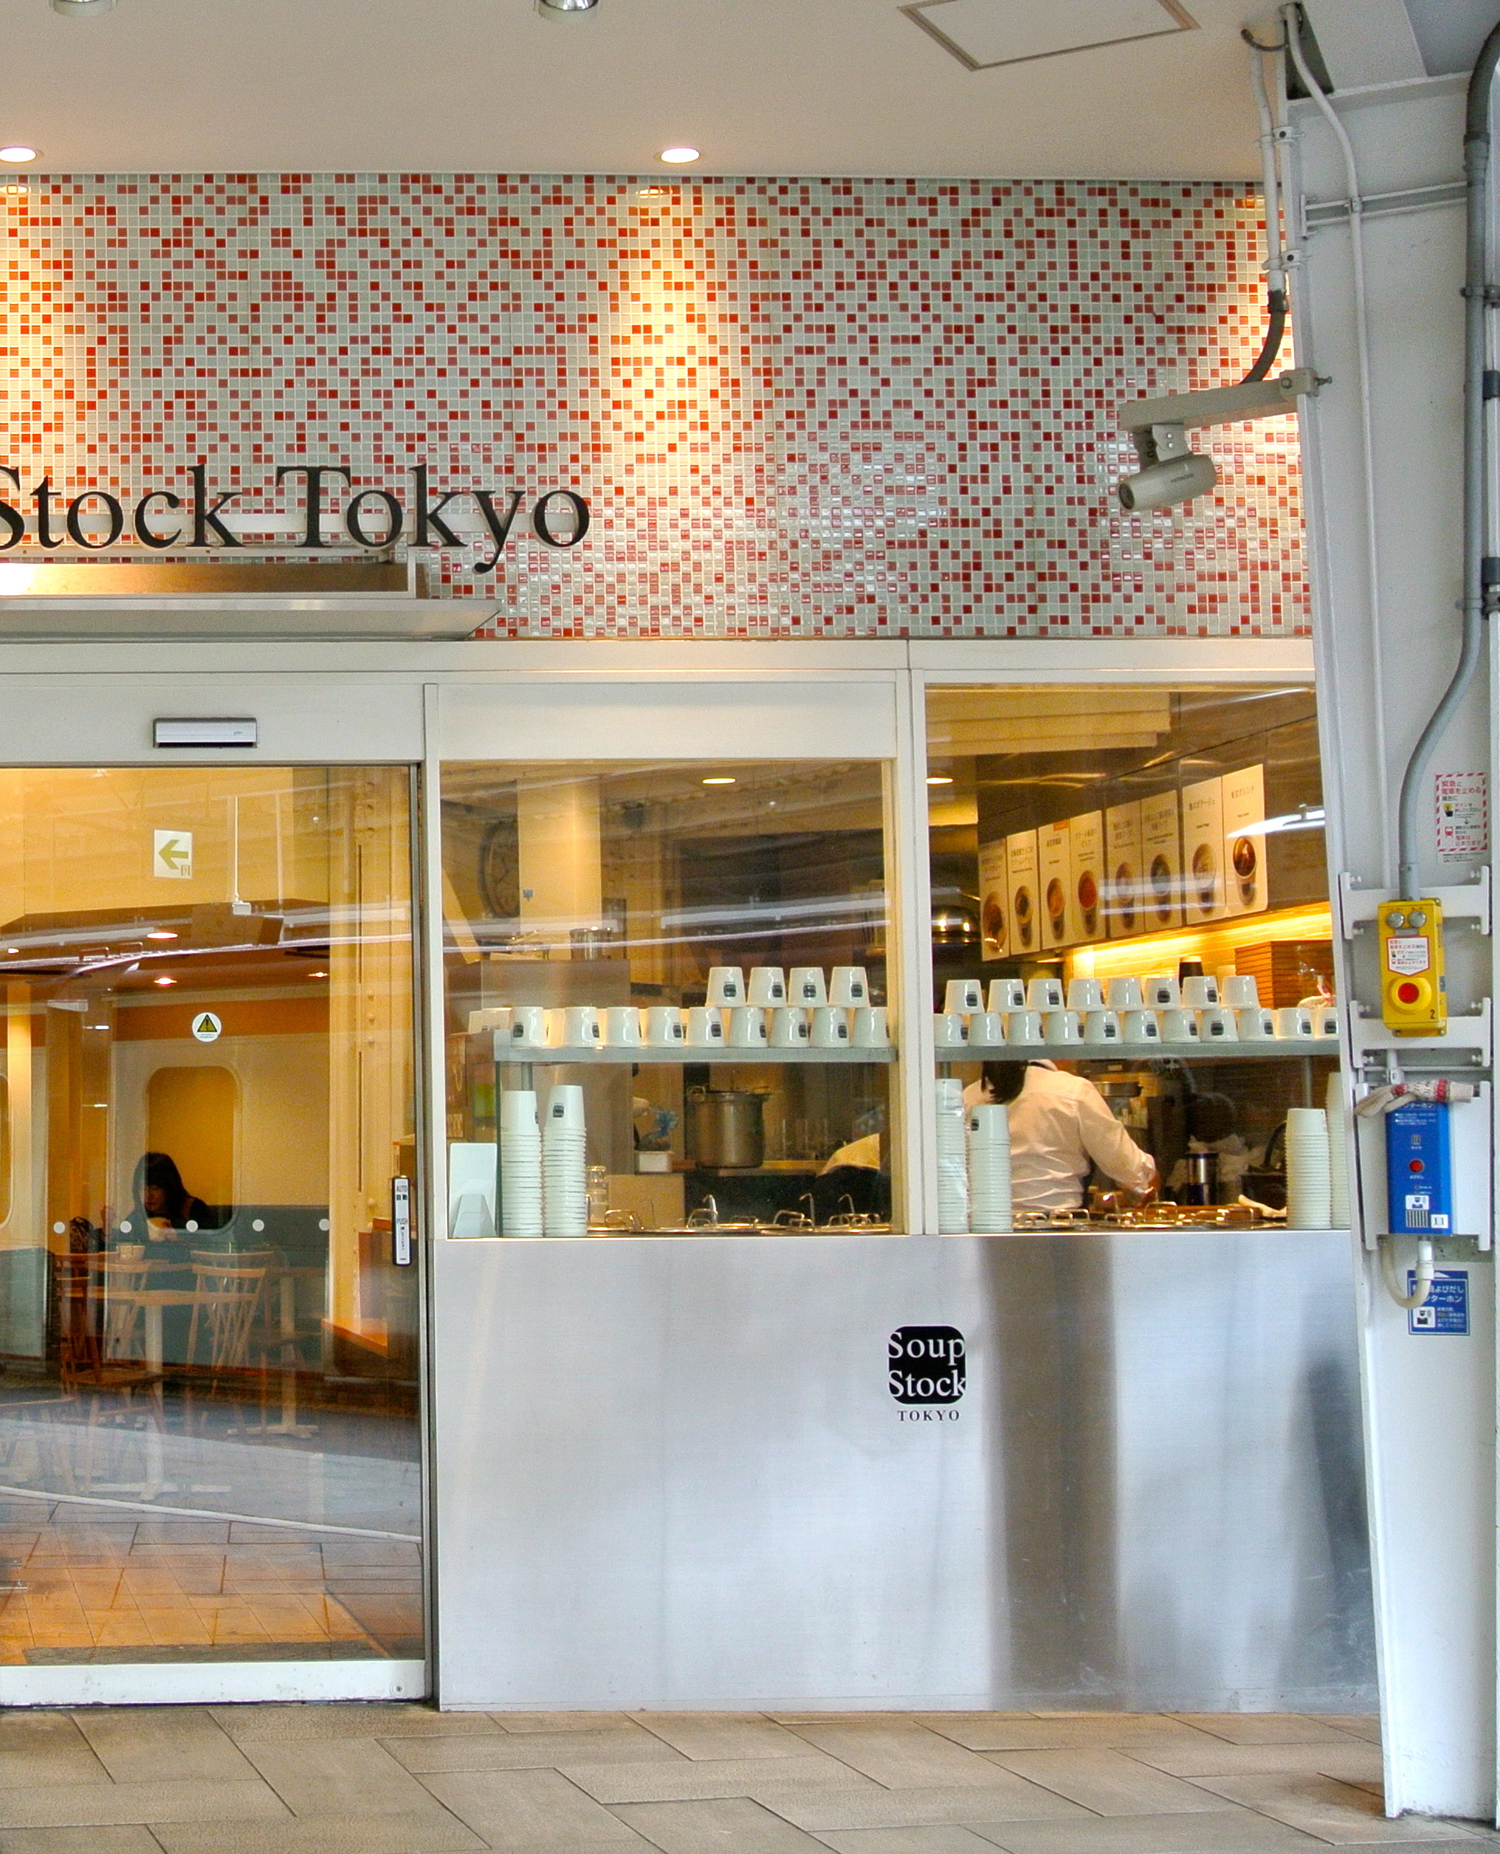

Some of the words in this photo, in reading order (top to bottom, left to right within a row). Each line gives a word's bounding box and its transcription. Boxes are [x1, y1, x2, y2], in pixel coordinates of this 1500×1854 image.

[276, 465, 590, 574] Tokyo
[888, 1331, 966, 1367] Soup
[888, 1368, 967, 1398] Stock
[897, 1409, 960, 1422] TOKYO
